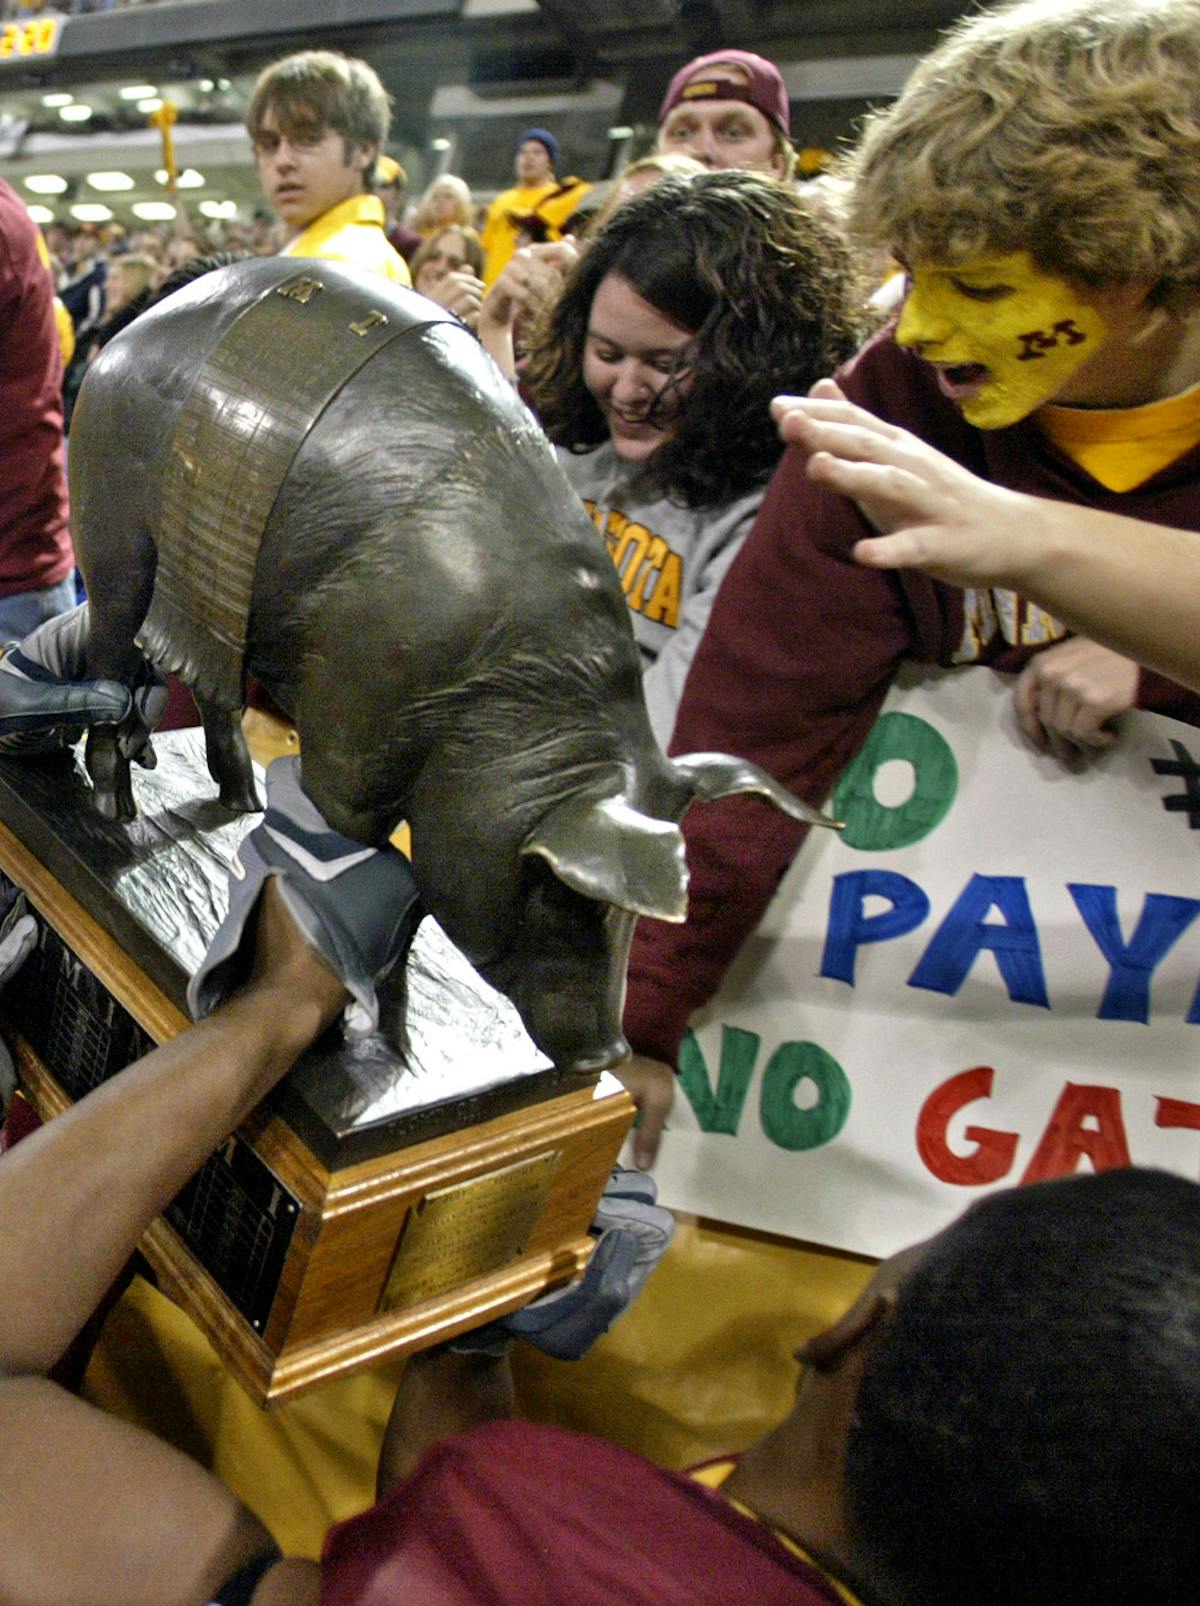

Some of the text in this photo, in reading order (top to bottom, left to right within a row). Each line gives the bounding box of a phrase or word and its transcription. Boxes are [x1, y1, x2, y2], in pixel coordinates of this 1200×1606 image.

[1016, 318, 1086, 361] M
[582, 499, 684, 630] OTA
[815, 868, 1200, 1026] PAY
